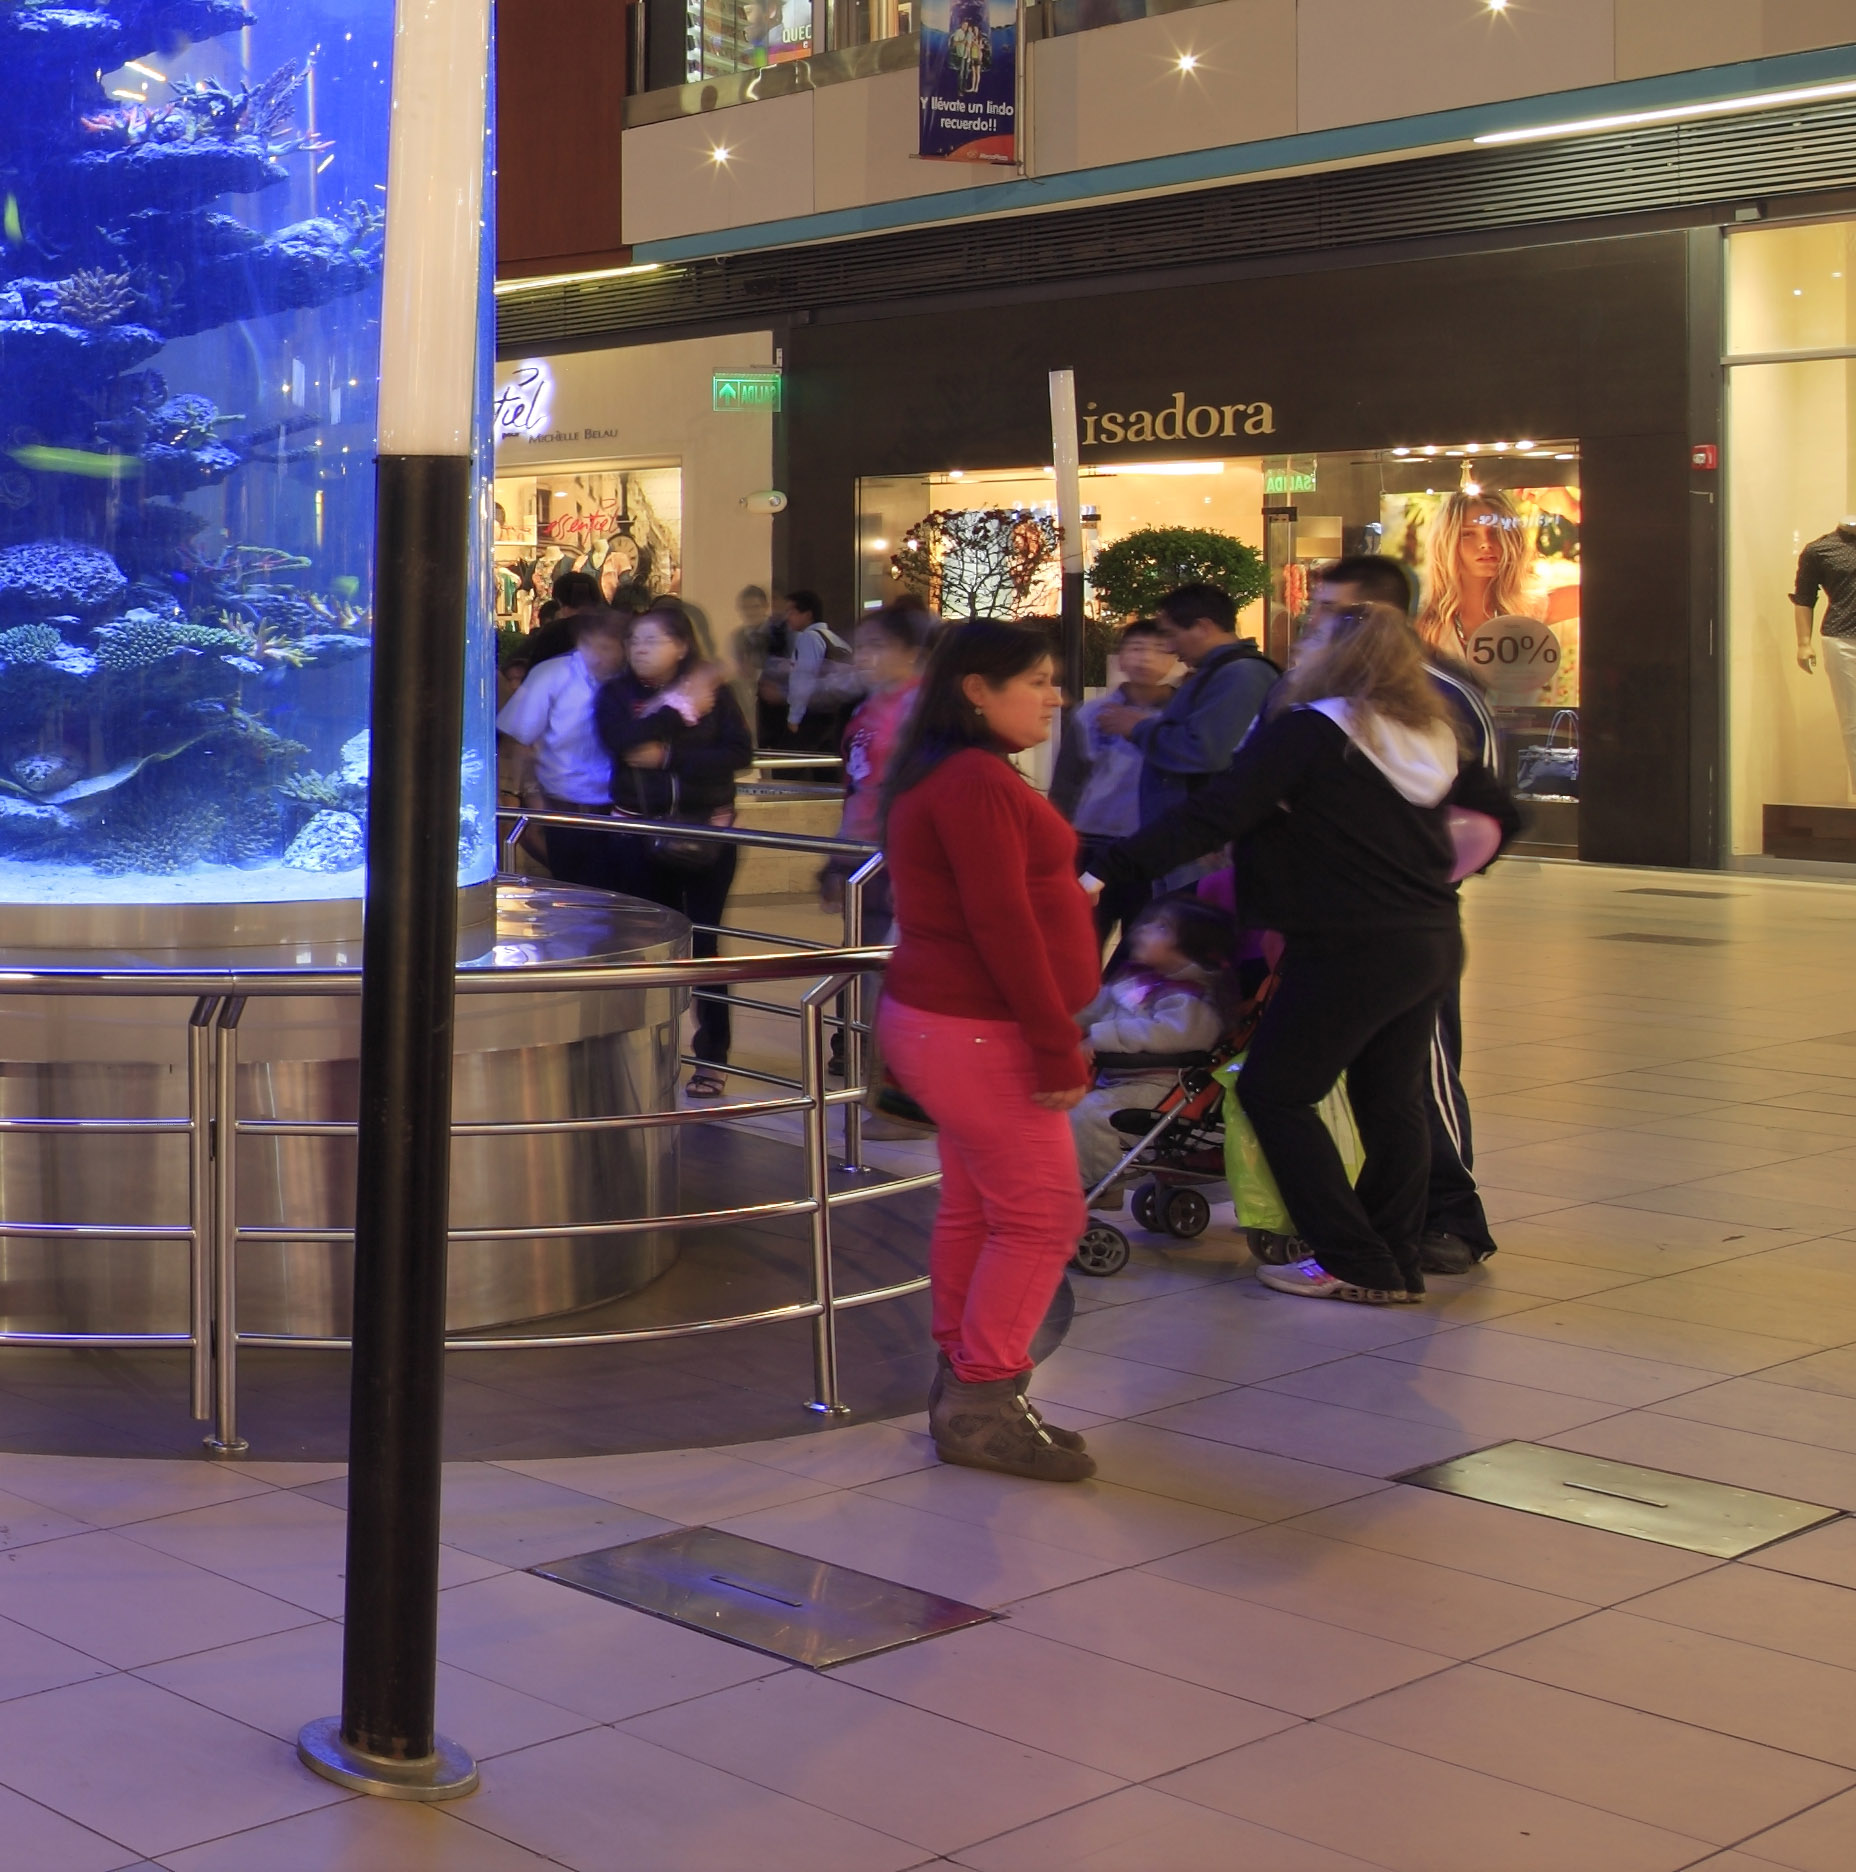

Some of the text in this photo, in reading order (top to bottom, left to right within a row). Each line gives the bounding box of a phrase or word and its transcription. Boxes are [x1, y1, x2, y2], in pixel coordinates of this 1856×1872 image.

[968, 103, 983, 114] un
[986, 100, 1014, 116] lindo
[1081, 391, 1277, 446] isadora
[1472, 634, 1558, 665] 50%
